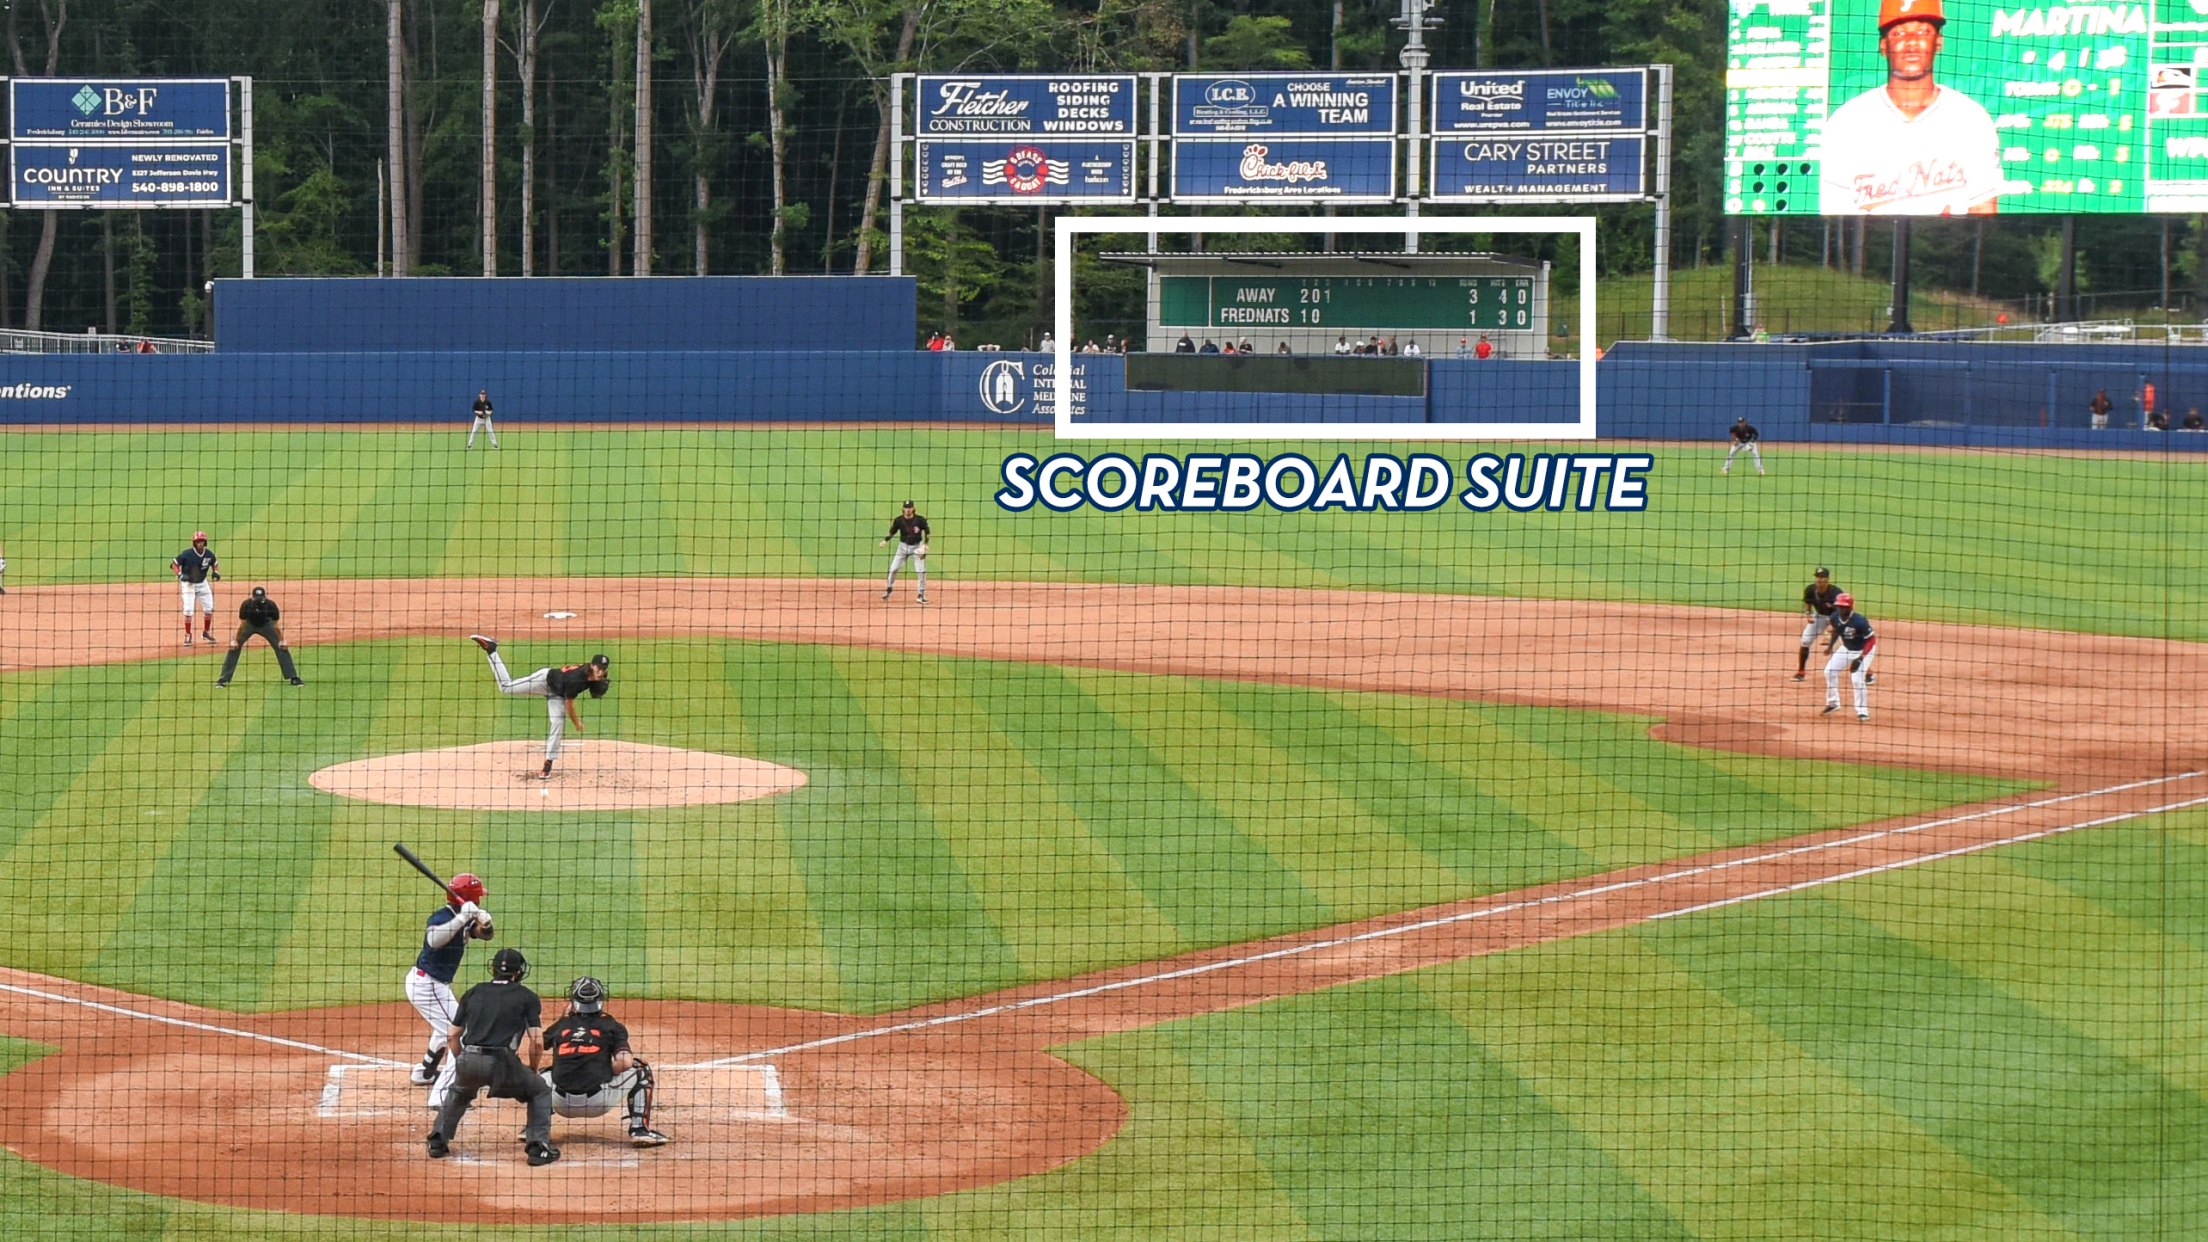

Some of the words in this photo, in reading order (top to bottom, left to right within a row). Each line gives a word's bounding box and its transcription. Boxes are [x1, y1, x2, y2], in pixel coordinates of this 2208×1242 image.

[1992, 5, 2147, 37] MARTINA
[1048, 82, 1119, 93] ROOFING
[1287, 82, 1331, 92] CHOOSE
[1460, 80, 1523, 95] United
[1546, 87, 1589, 99] ENVOY
[103, 88, 157, 115] B&F
[931, 82, 1029, 115] Fletcher
[1057, 95, 1111, 106] SIDING
[1272, 93, 1286, 108] A
[1289, 92, 1369, 108] WINNING
[1460, 102, 1485, 111] Real
[1486, 101, 1522, 111] Estate
[1058, 108, 1109, 118] DECKS
[1318, 108, 1368, 124] TEAM
[929, 120, 1031, 131] CONSTRUCTION
[1043, 121, 1124, 131] WINDOWS
[1464, 143, 1522, 161] CARY
[1526, 142, 1611, 160] STREET
[1527, 163, 1607, 174] PARTNERS
[131, 182, 218, 192] 540-898-1800
[1464, 185, 1513, 193] WEALTH
[1518, 184, 1607, 193] MANAGEMENT
[1236, 288, 1276, 303] AWAY
[1469, 289, 1478, 304] 3
[1498, 289, 1507, 304] 4
[1518, 289, 1527, 304] 0
[1221, 308, 1289, 323] FREDNATS
[1469, 310, 1476, 325] 1
[1498, 310, 1507, 325] 3
[1517, 310, 1526, 325] 0
[0, 383, 68, 399] ntions
